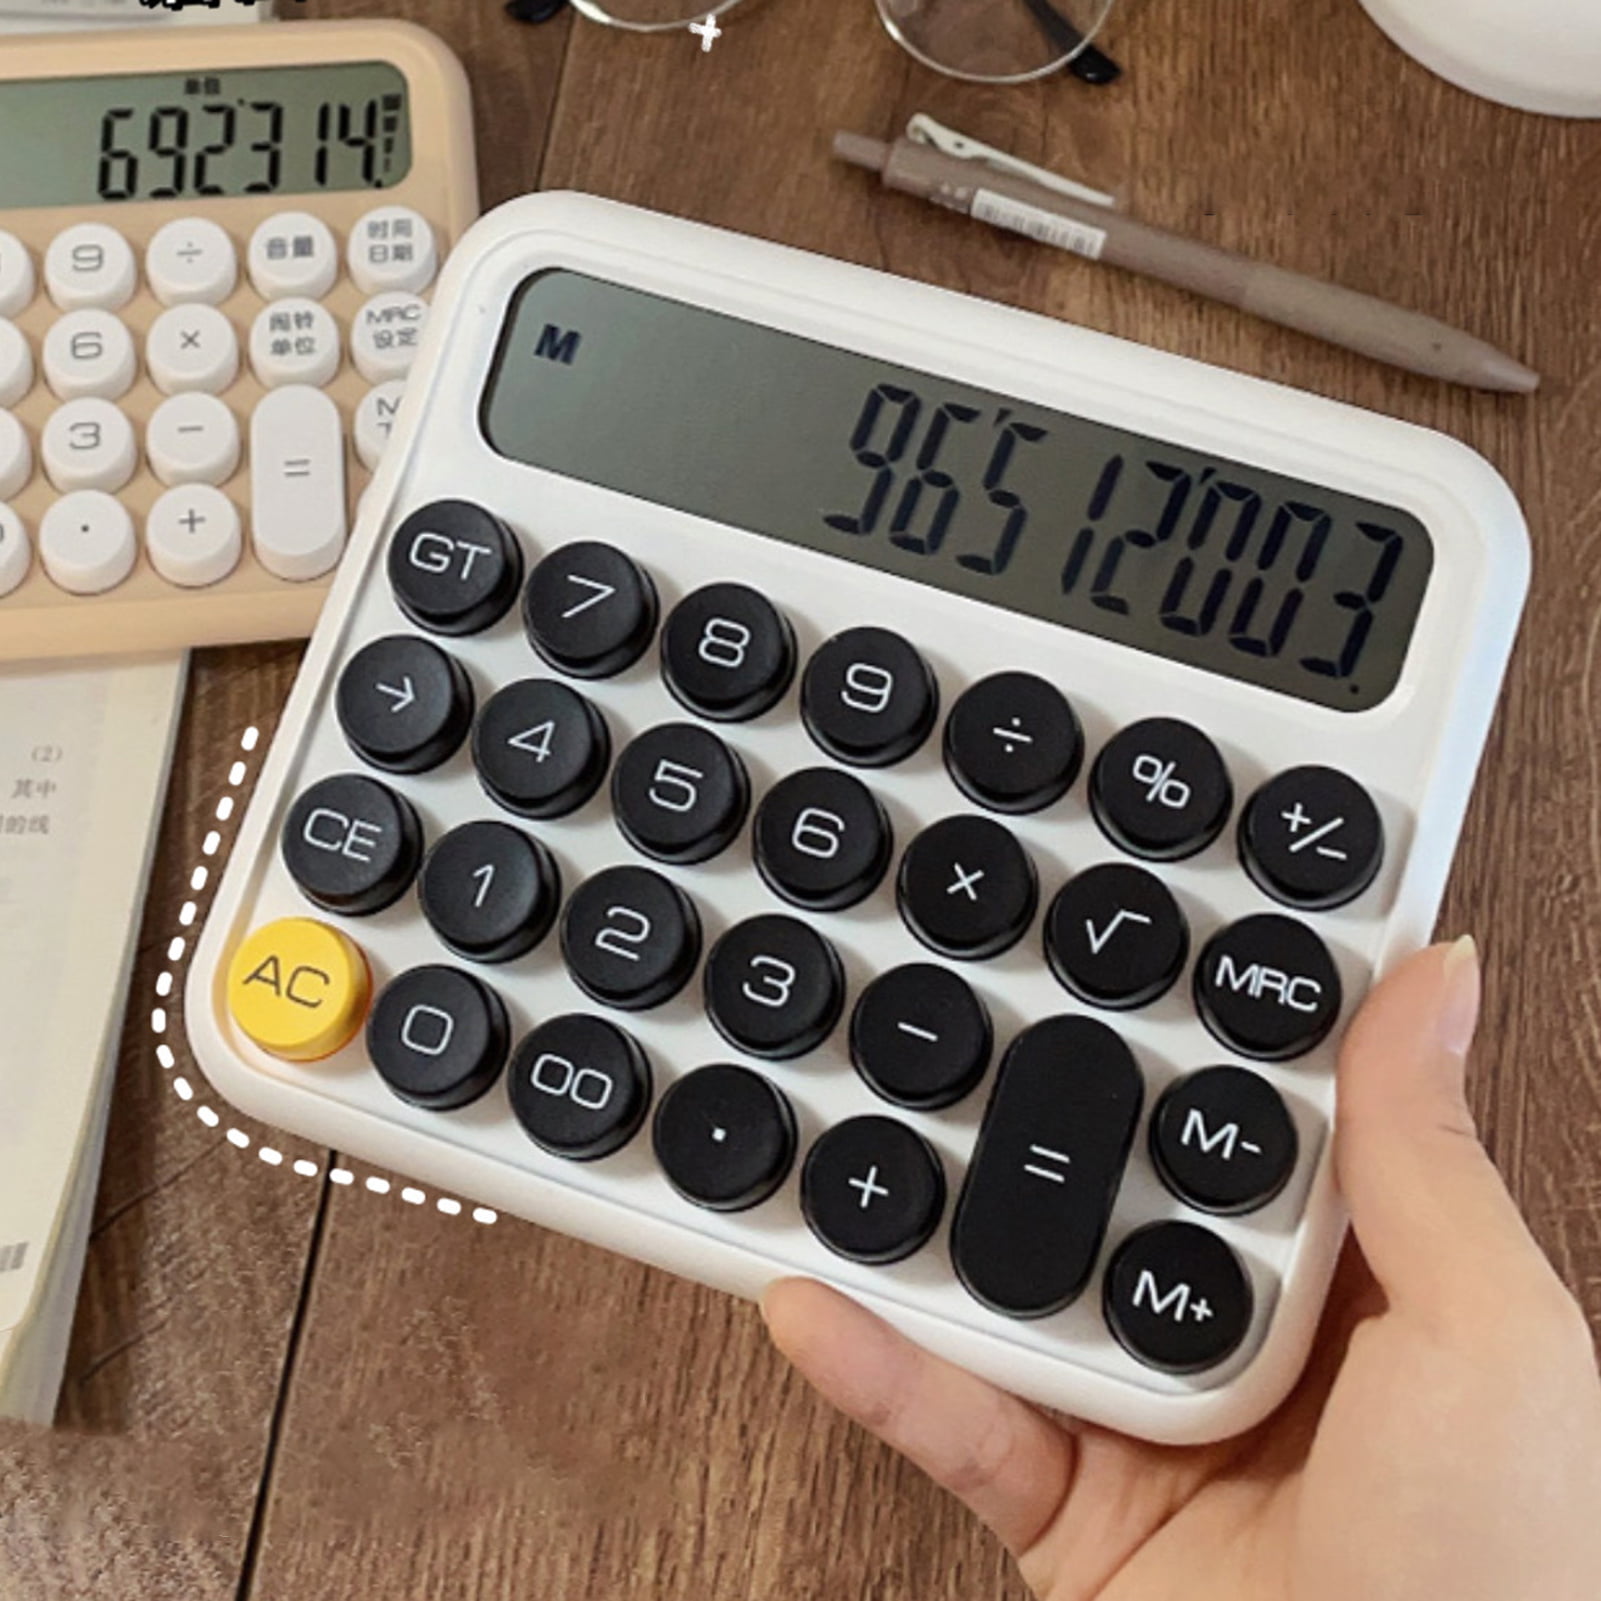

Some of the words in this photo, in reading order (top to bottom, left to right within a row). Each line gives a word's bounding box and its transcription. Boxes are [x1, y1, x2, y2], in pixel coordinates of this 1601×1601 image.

[72, 244, 105, 273] 9
[70, 331, 103, 361] 6
[535, 324, 580, 364] M
[69, 421, 101, 451] 3
[409, 531, 492, 581] GT
[562, 574, 616, 619] 7
[698, 618, 751, 668] 8
[841, 663, 893, 713] 9
[507, 720, 556, 763] 4
[649, 759, 703, 812] 5
[1132, 755, 1191, 809] %
[302, 807, 383, 863] CE
[792, 807, 846, 859] 6
[472, 864, 495, 908] 1
[595, 905, 651, 961] 2
[241, 954, 331, 1010] AC
[742, 955, 796, 1007] 3
[1214, 955, 1322, 1013] MRC
[401, 1003, 454, 1056] 0
[530, 1052, 614, 1110] 00
[1180, 1109, 1262, 1160] M-
[1131, 1269, 1214, 1323] M+
